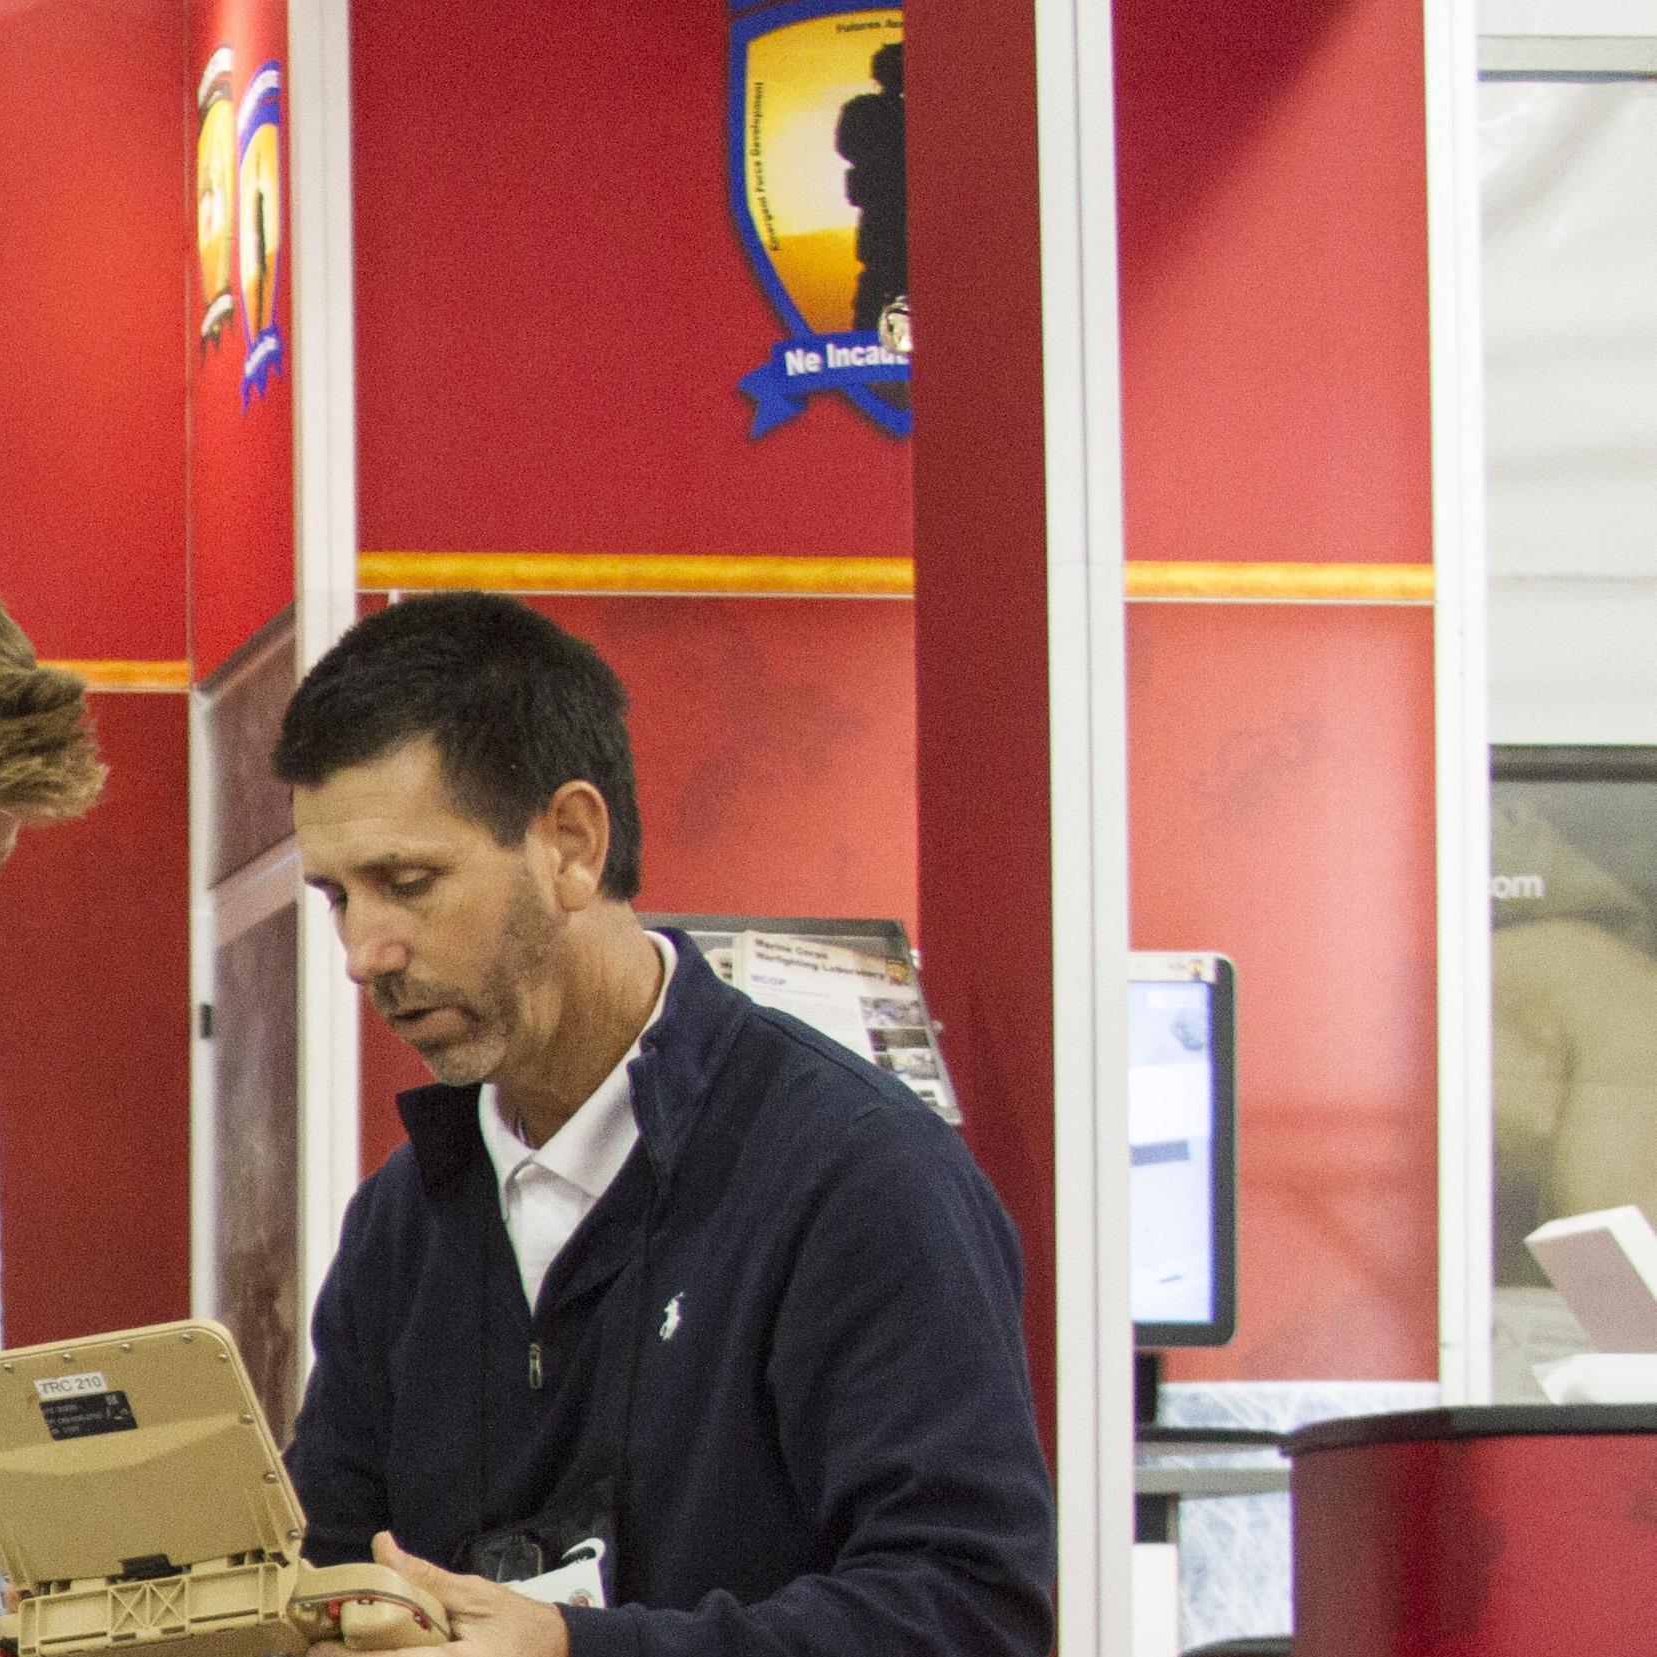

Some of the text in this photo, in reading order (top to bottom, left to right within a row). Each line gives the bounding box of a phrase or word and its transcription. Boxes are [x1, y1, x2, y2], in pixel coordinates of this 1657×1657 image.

[784, 342, 910, 377] Ne Incau
[38, 1375, 103, 1394] TRC 210
